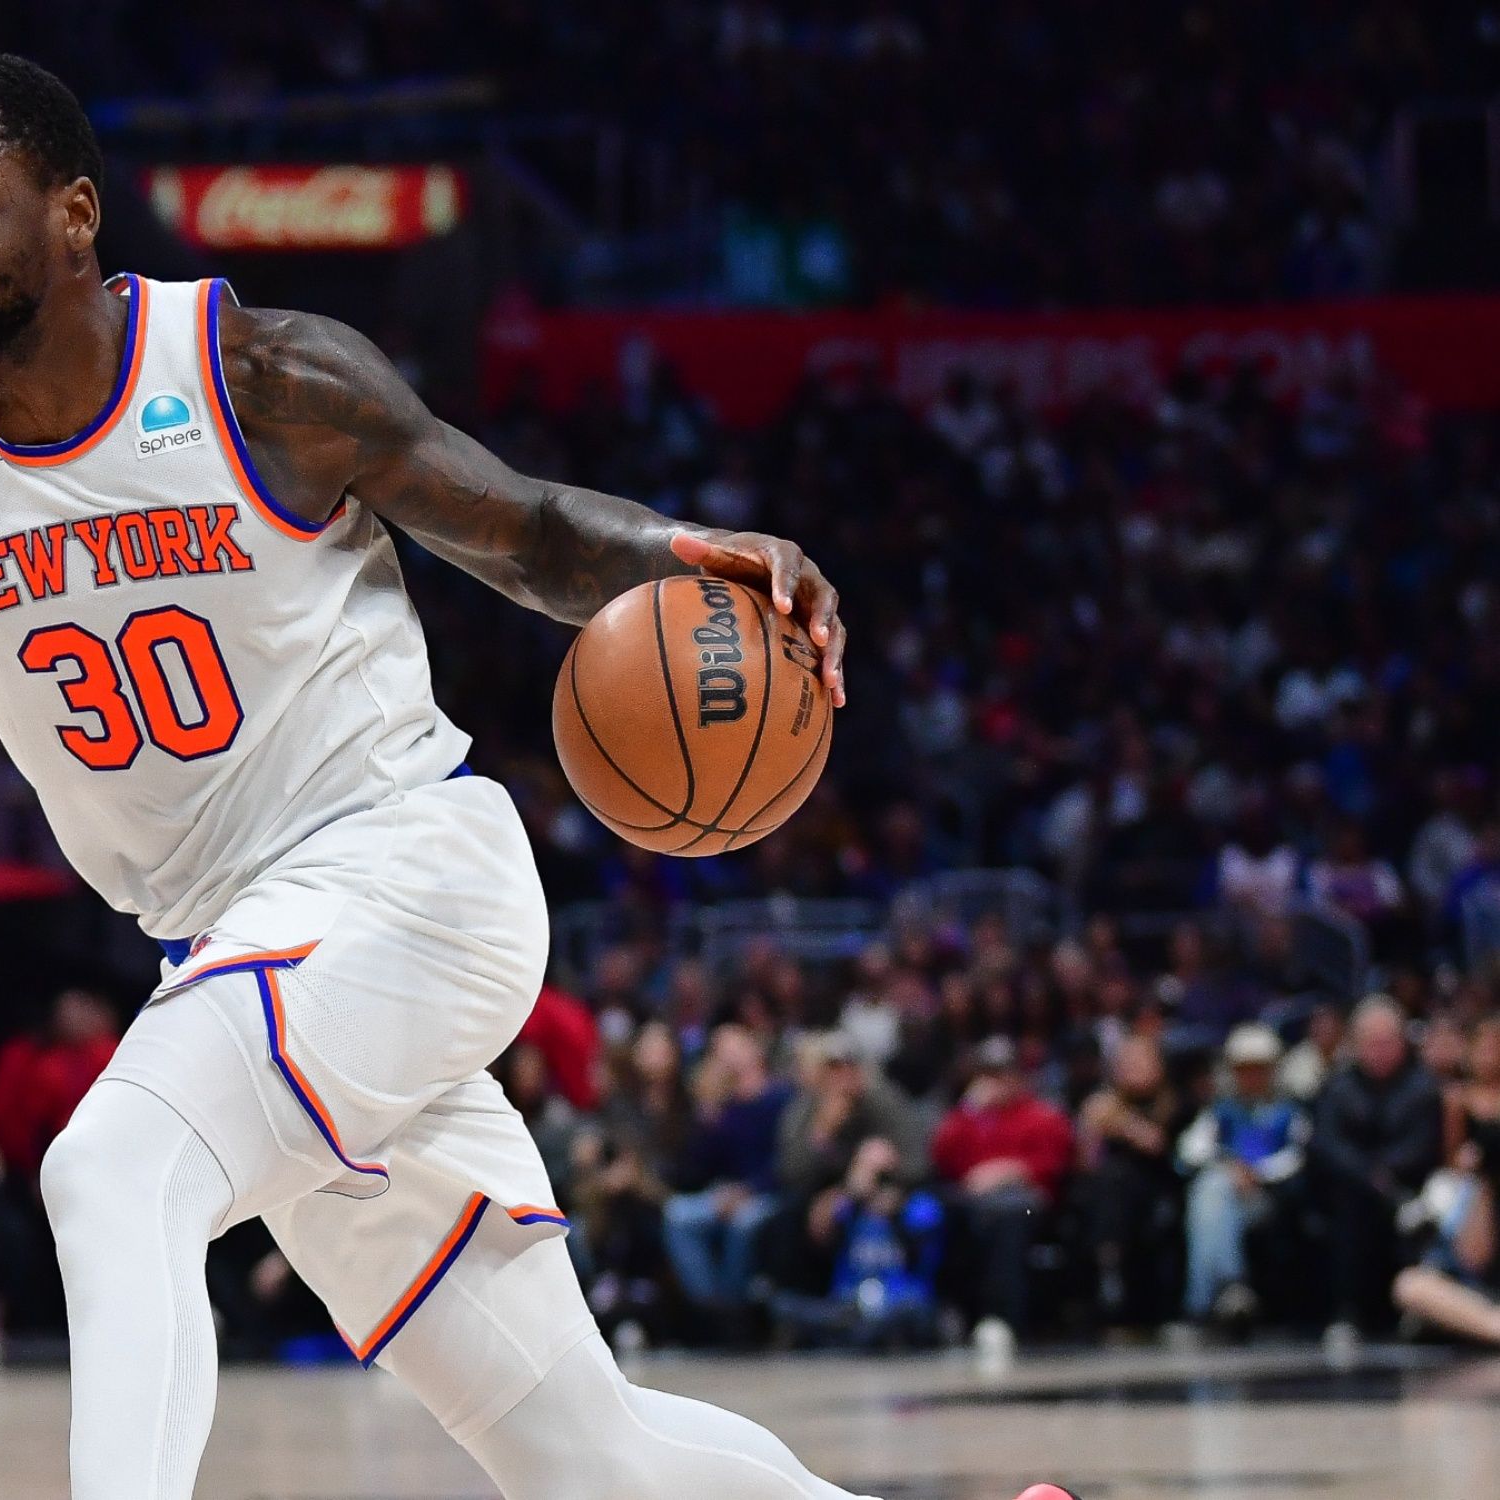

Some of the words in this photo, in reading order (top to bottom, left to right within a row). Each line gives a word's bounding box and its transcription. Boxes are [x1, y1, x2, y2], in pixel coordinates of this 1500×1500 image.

[139, 428, 202, 454] sphere
[73, 502, 256, 590] YORK
[17, 603, 245, 772] 30
[693, 579, 747, 728] Wilson
